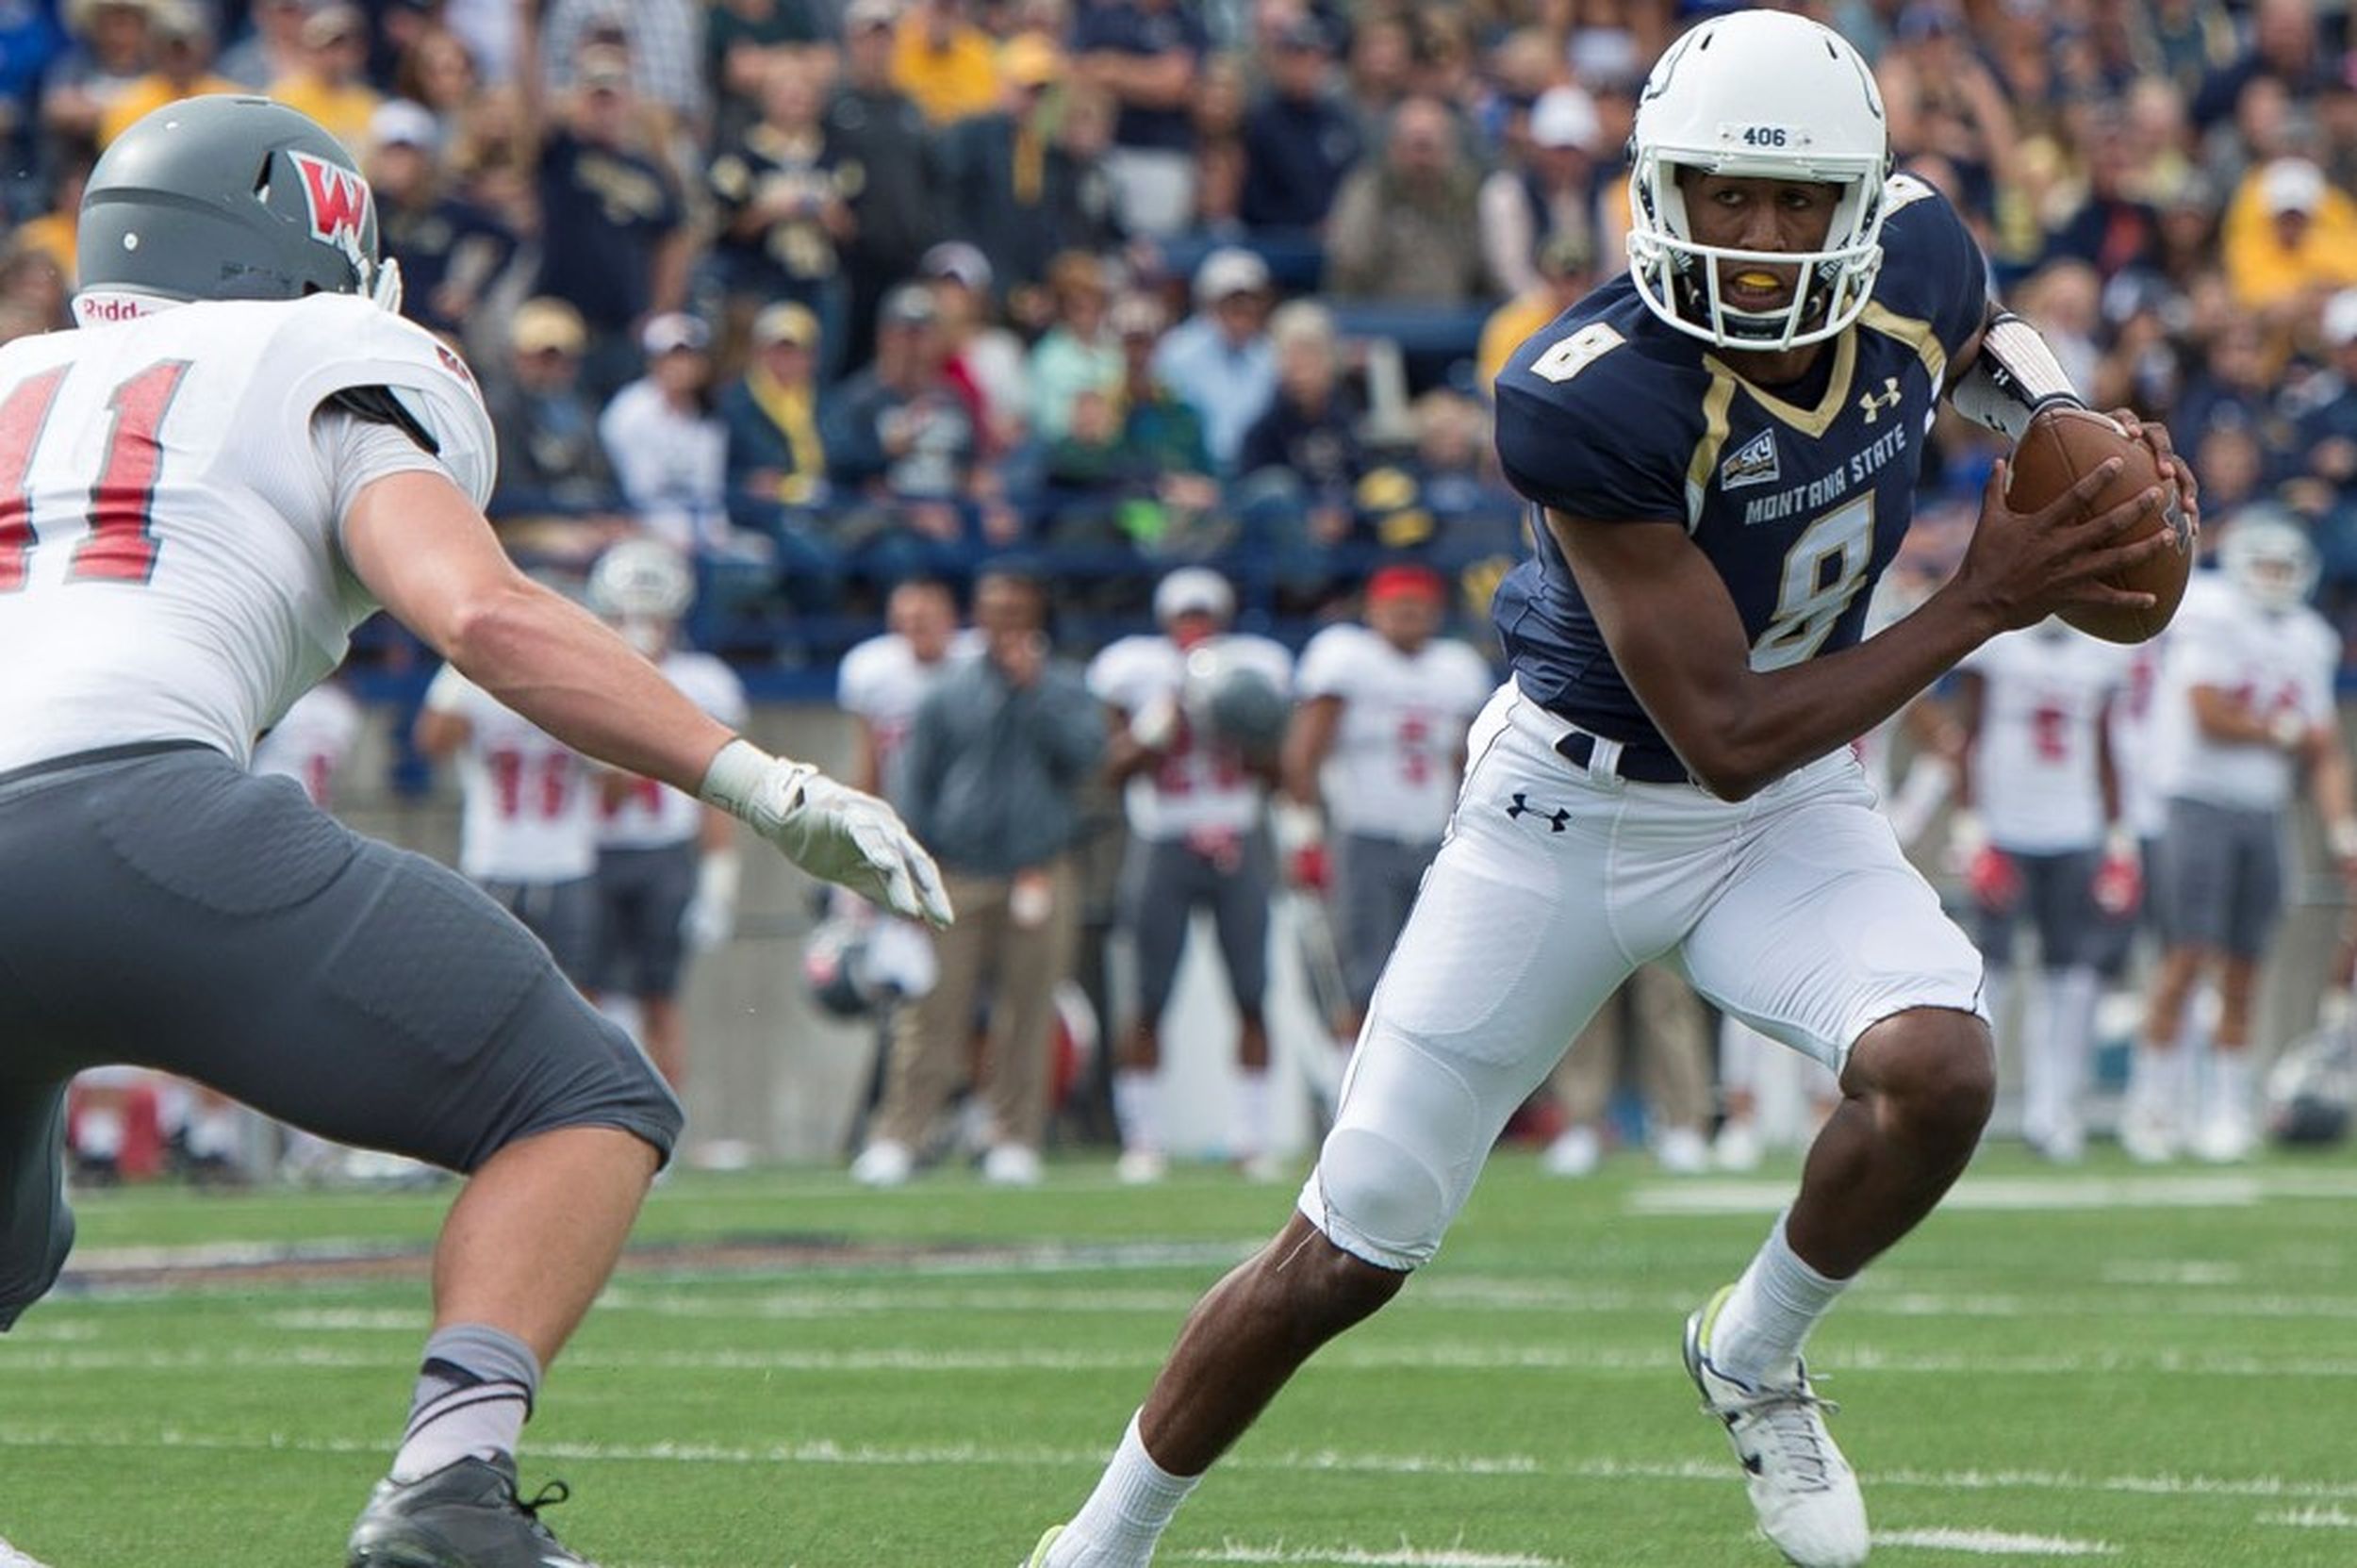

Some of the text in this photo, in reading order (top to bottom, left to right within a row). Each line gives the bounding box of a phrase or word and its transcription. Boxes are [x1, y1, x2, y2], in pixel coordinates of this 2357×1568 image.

[1743, 126, 1786, 147] 406
[287, 150, 370, 249] W
[83, 298, 155, 322] Ridd
[1529, 322, 1627, 384] 8
[0, 357, 195, 594] 11
[1745, 421, 1907, 526] MONTANA STATE
[1749, 487, 1875, 674] 8
